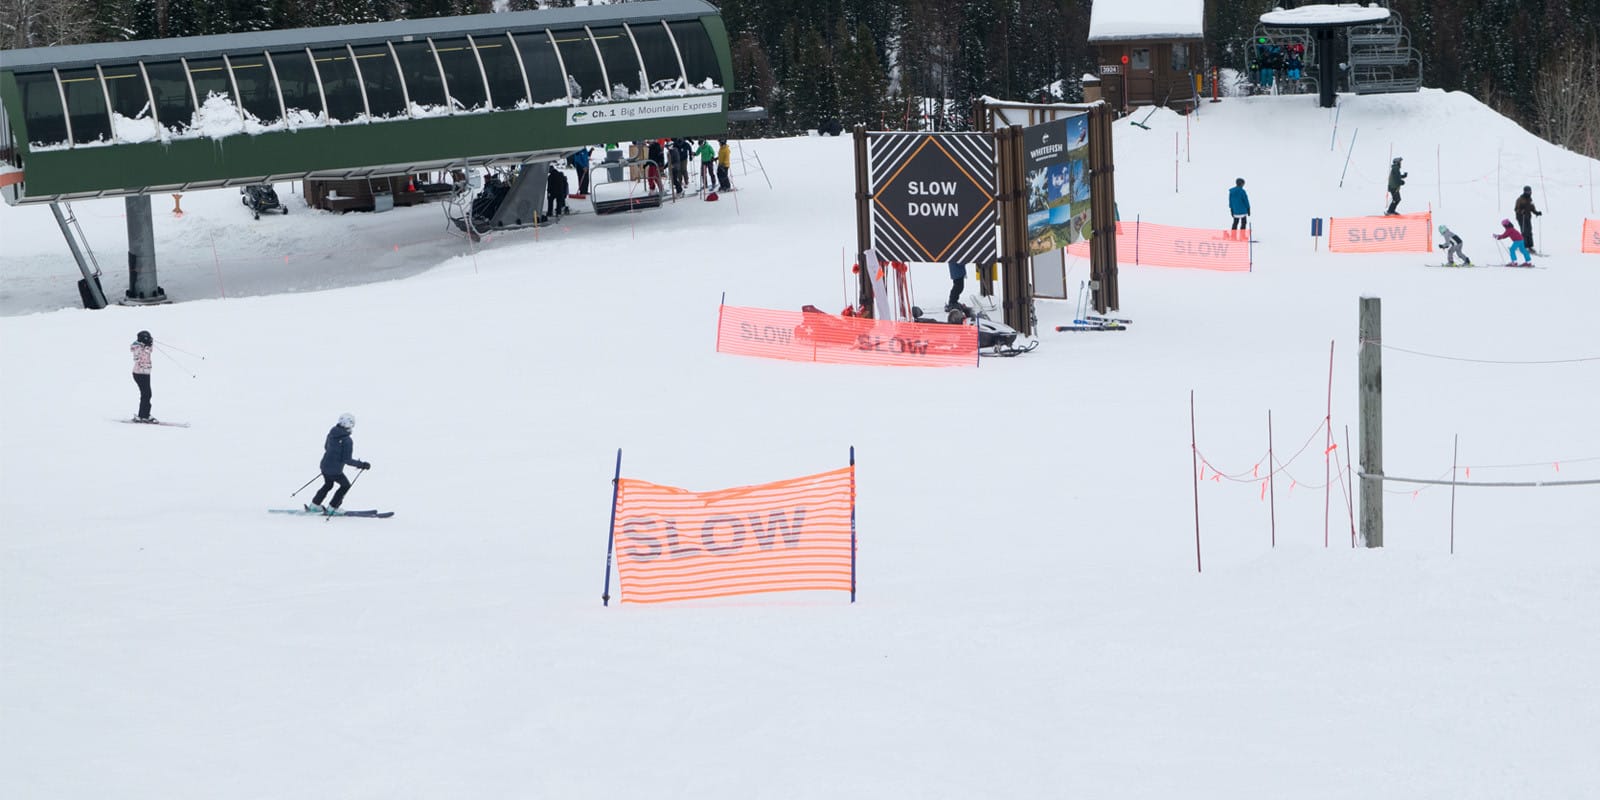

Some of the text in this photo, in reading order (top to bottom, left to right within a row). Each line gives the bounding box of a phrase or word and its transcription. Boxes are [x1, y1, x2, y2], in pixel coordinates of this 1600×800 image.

[592, 100, 718, 118] Ch. 1 Big Mountain Express
[1030, 143, 1063, 159] WHITEFISH
[908, 181, 957, 195] SLOW
[908, 202, 959, 217] DOWN
[1348, 225, 1407, 242] SLOW
[1174, 239, 1229, 257] SLOW
[740, 322, 792, 344] SLOW
[857, 333, 928, 355] SLOW
[623, 506, 806, 562] SLOW
